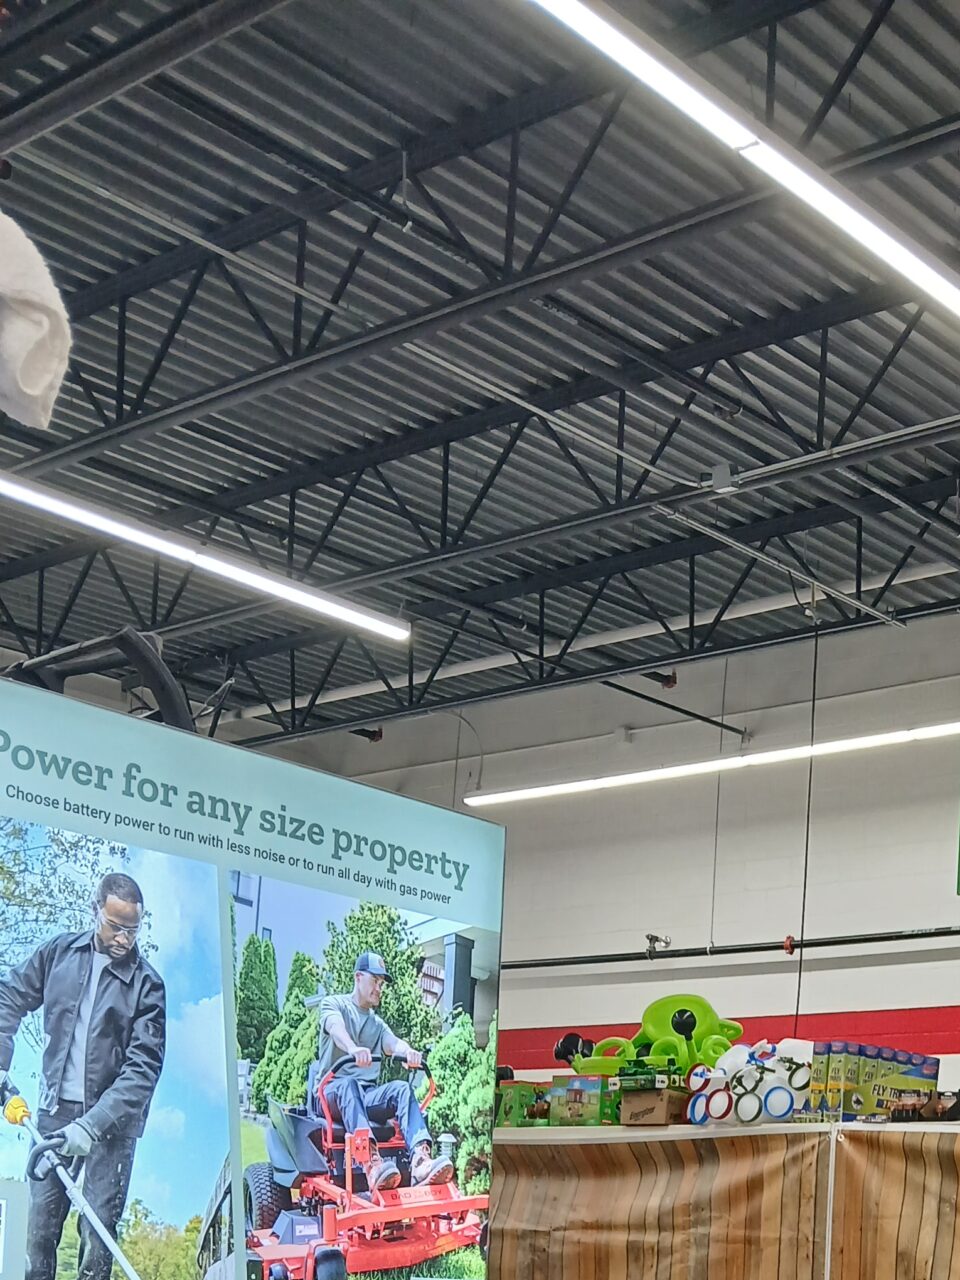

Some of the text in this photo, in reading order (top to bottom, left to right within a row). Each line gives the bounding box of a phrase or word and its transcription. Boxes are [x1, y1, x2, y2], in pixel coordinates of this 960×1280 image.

[6, 785, 451, 905] Choose battery power to run with less noise or to run all day with gas power
[122, 763, 178, 807] for
[186, 790, 252, 836] any
[259, 805, 324, 845] size
[331, 828, 470, 891] property
[872, 1084, 888, 1097] FLY
